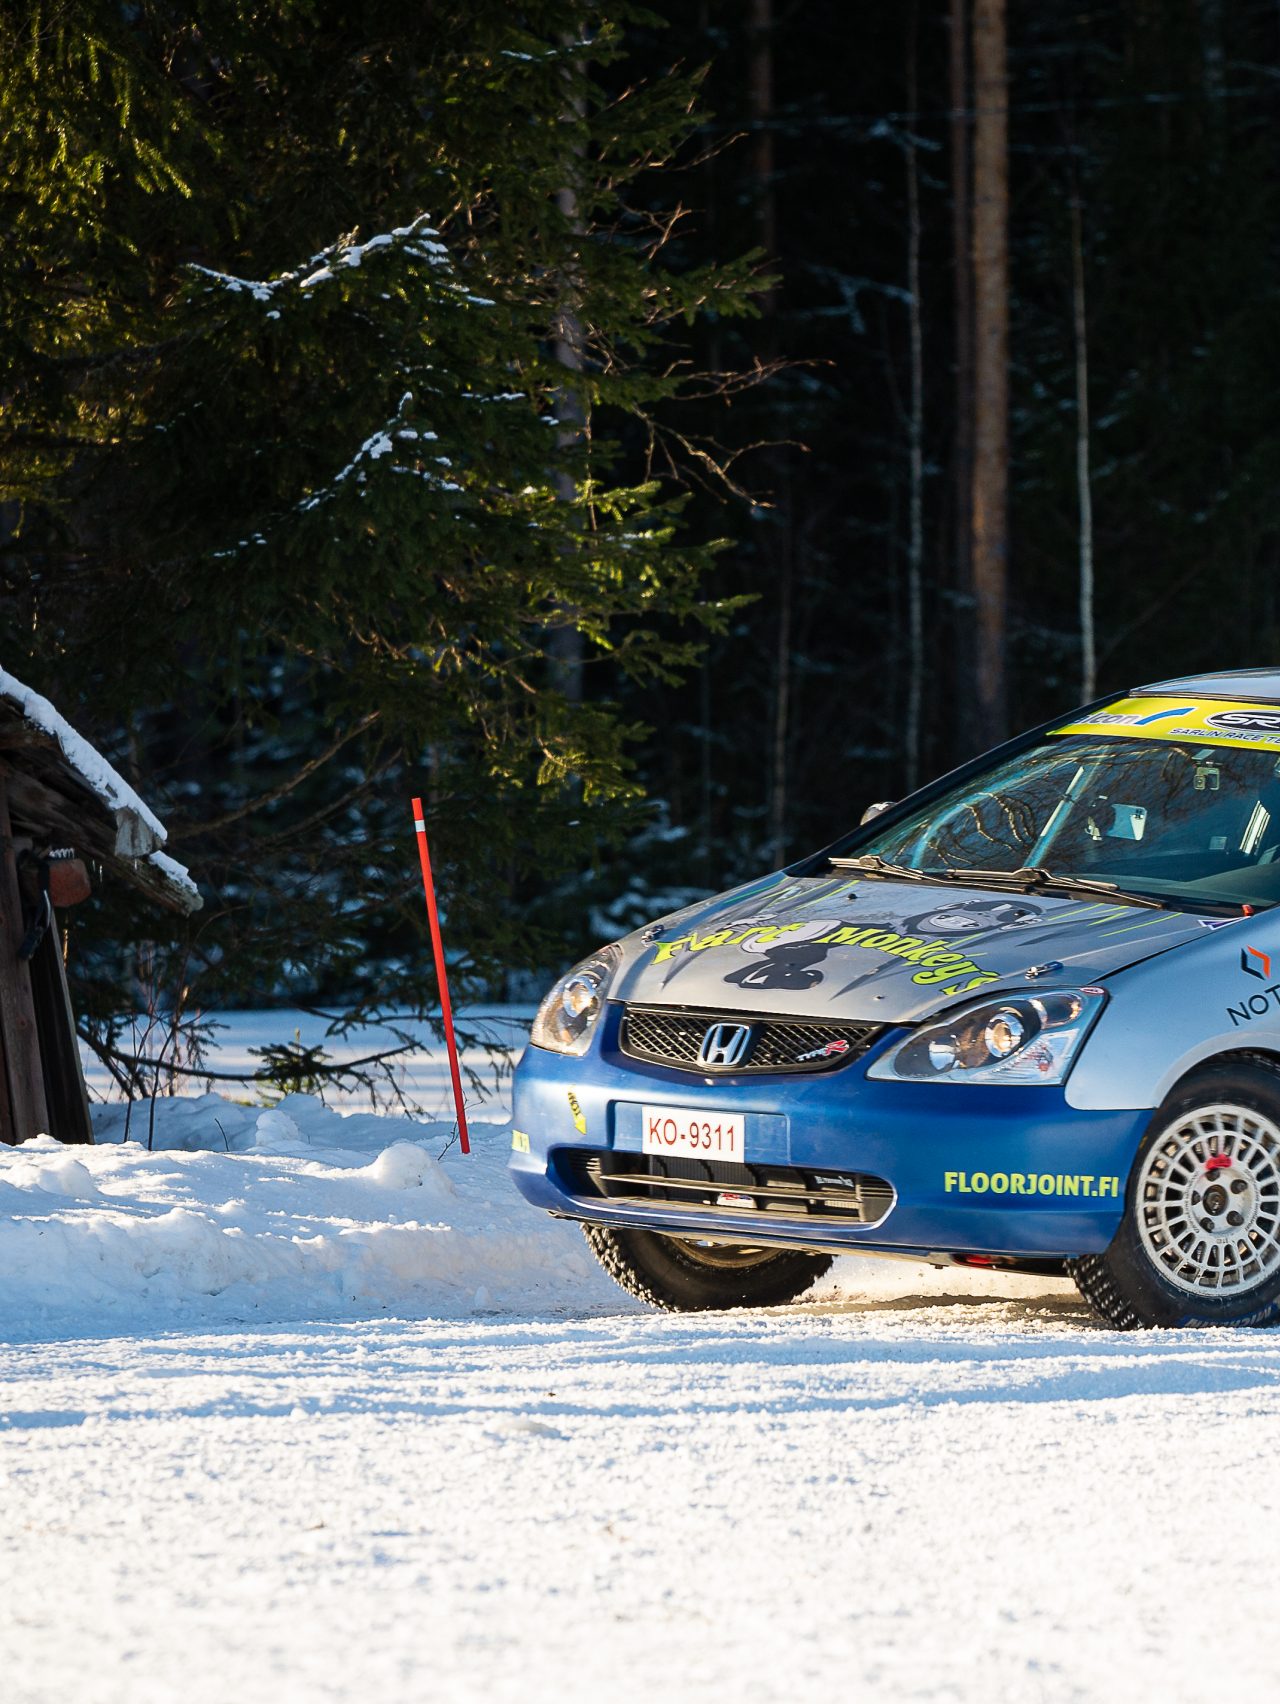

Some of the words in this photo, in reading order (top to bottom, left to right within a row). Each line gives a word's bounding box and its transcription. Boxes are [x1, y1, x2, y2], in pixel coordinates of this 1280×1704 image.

[1170, 727, 1221, 738] SARLIN
[1224, 730, 1263, 742] RACE
[649, 1117, 734, 1152] KO-9311
[944, 1171, 1120, 1198] FLOORJOINT.FI
